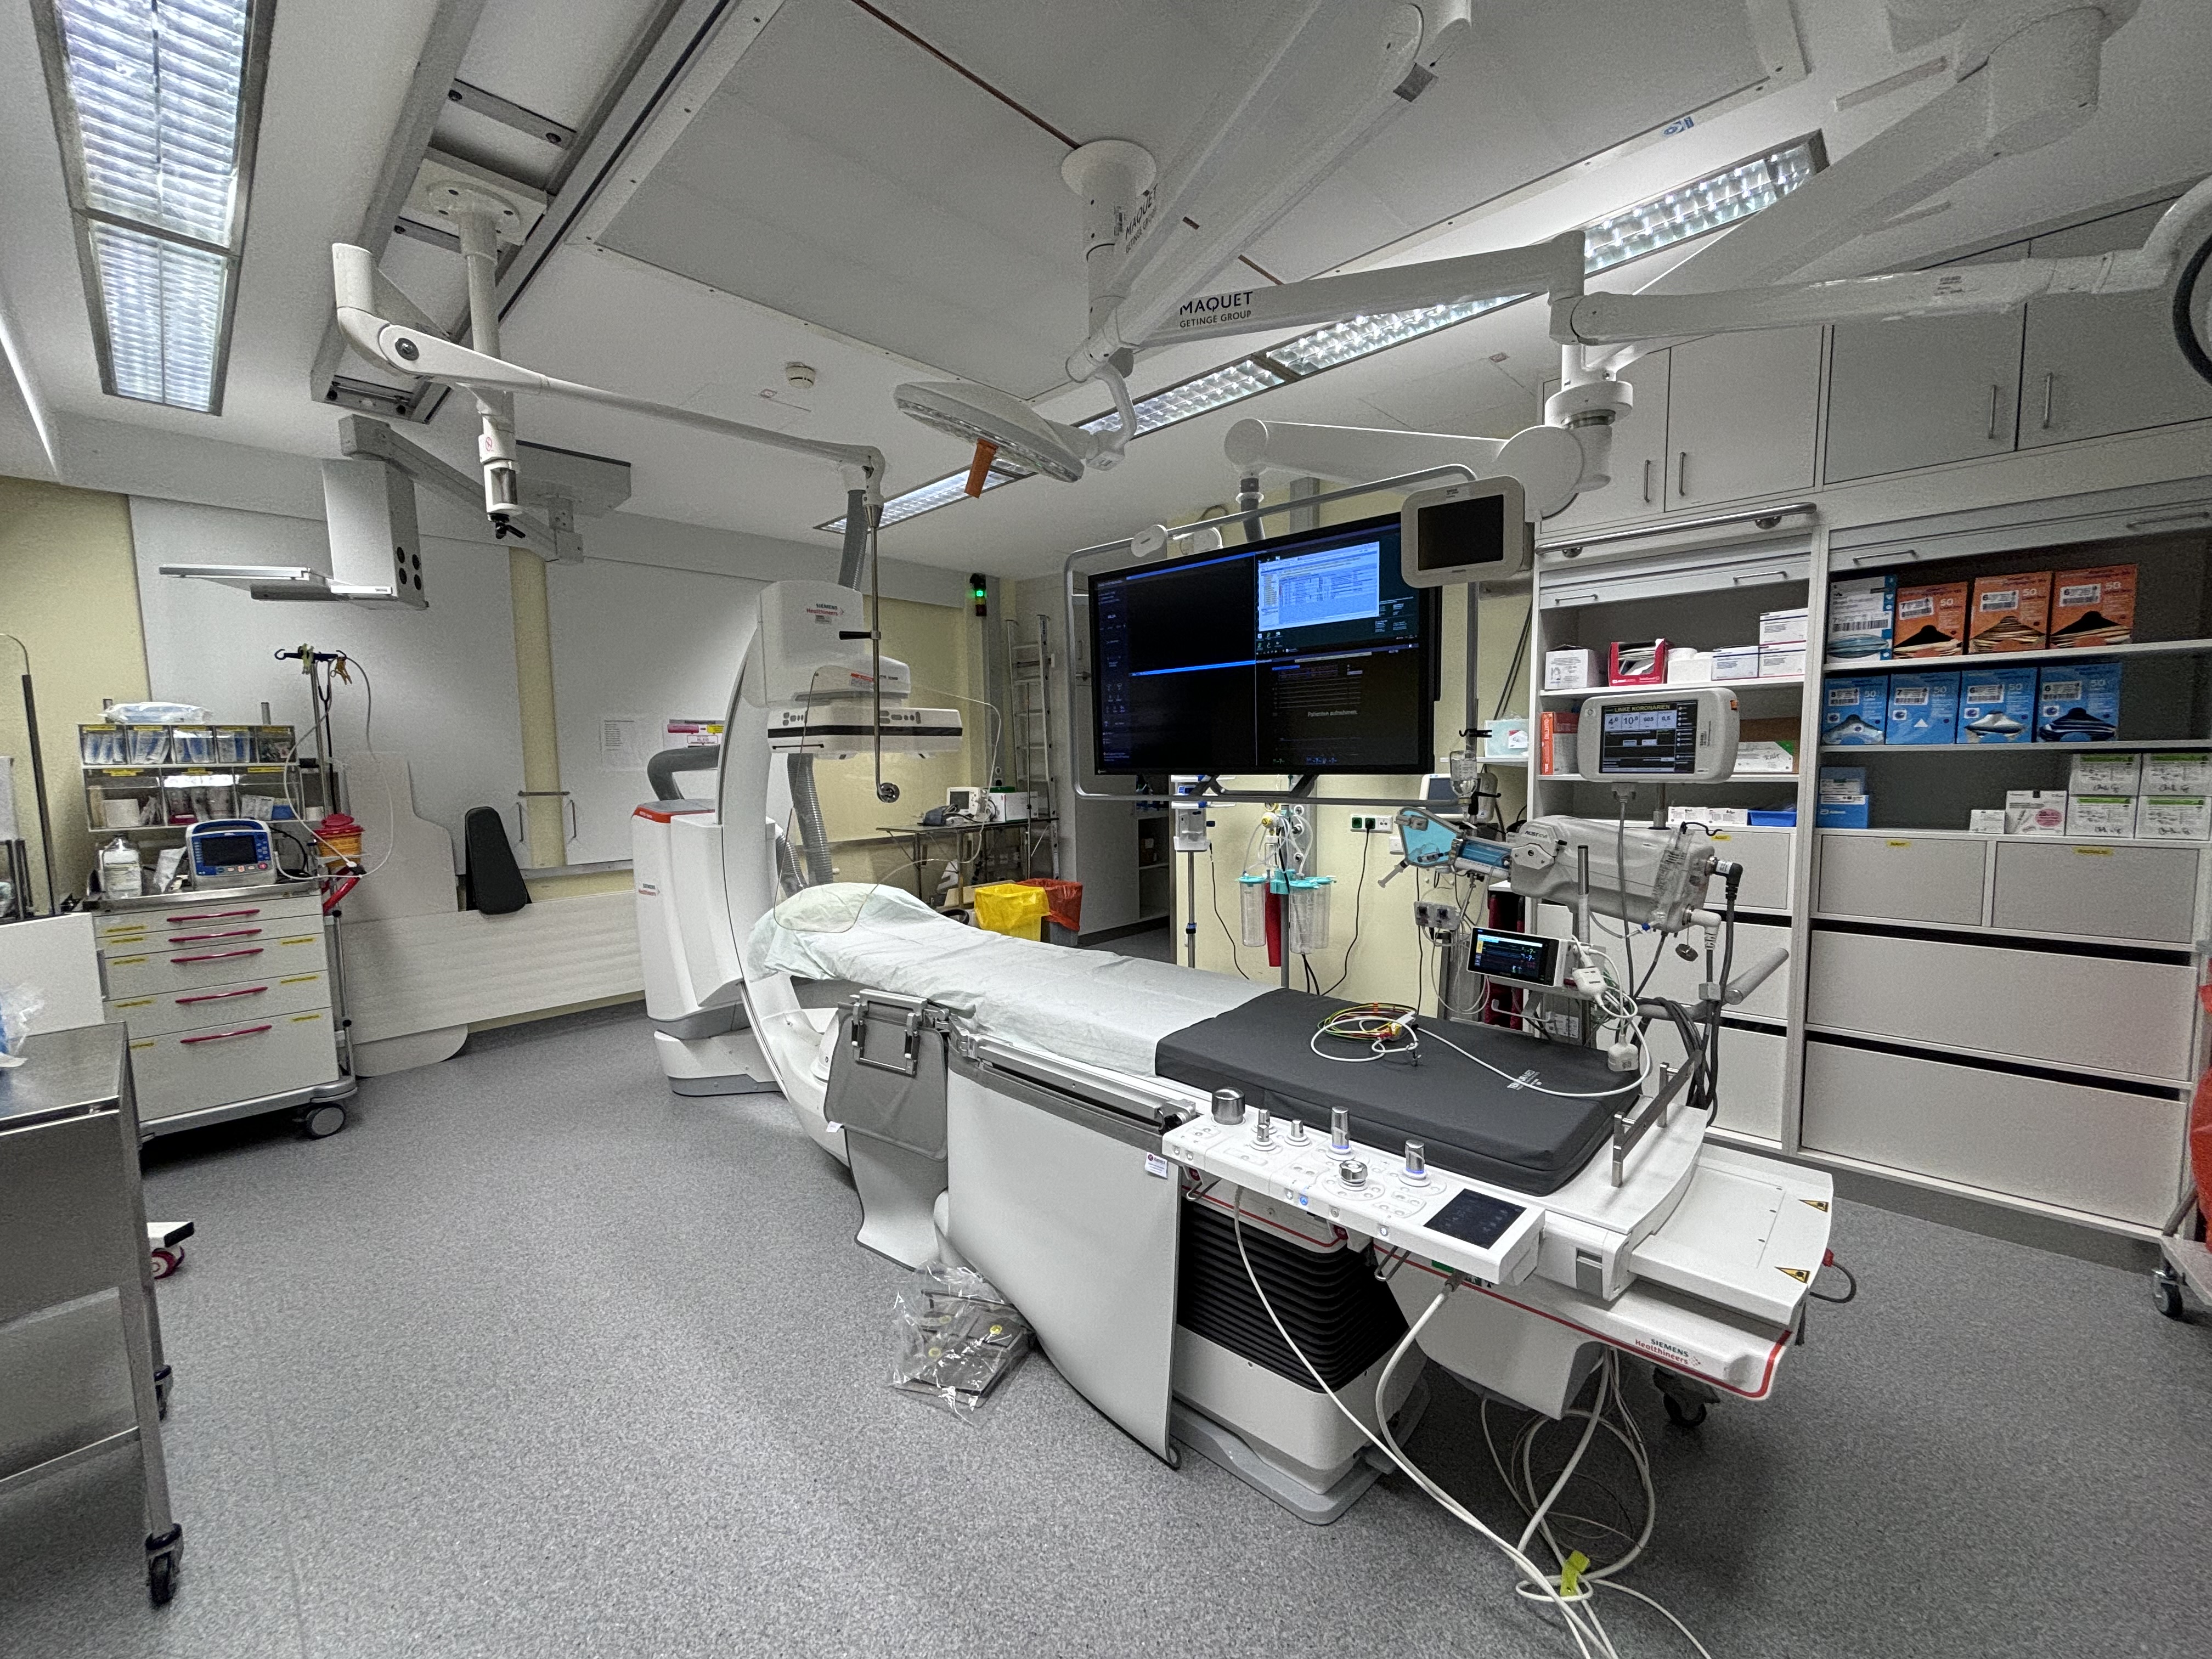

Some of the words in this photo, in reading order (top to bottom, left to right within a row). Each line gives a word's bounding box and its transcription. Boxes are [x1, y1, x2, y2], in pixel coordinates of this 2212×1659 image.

[1125, 183, 1158, 240] MAQUET
[1180, 291, 1253, 315] MAQUET
[1180, 315, 1217, 328] GETINGE
[1221, 310, 1251, 321] GROUP
[2022, 588, 2037, 596] 50
[1940, 598, 1954, 606] 50
[1635, 1339, 1689, 1365] Healthineers
[1651, 1338, 1689, 1357] SIEMENS
